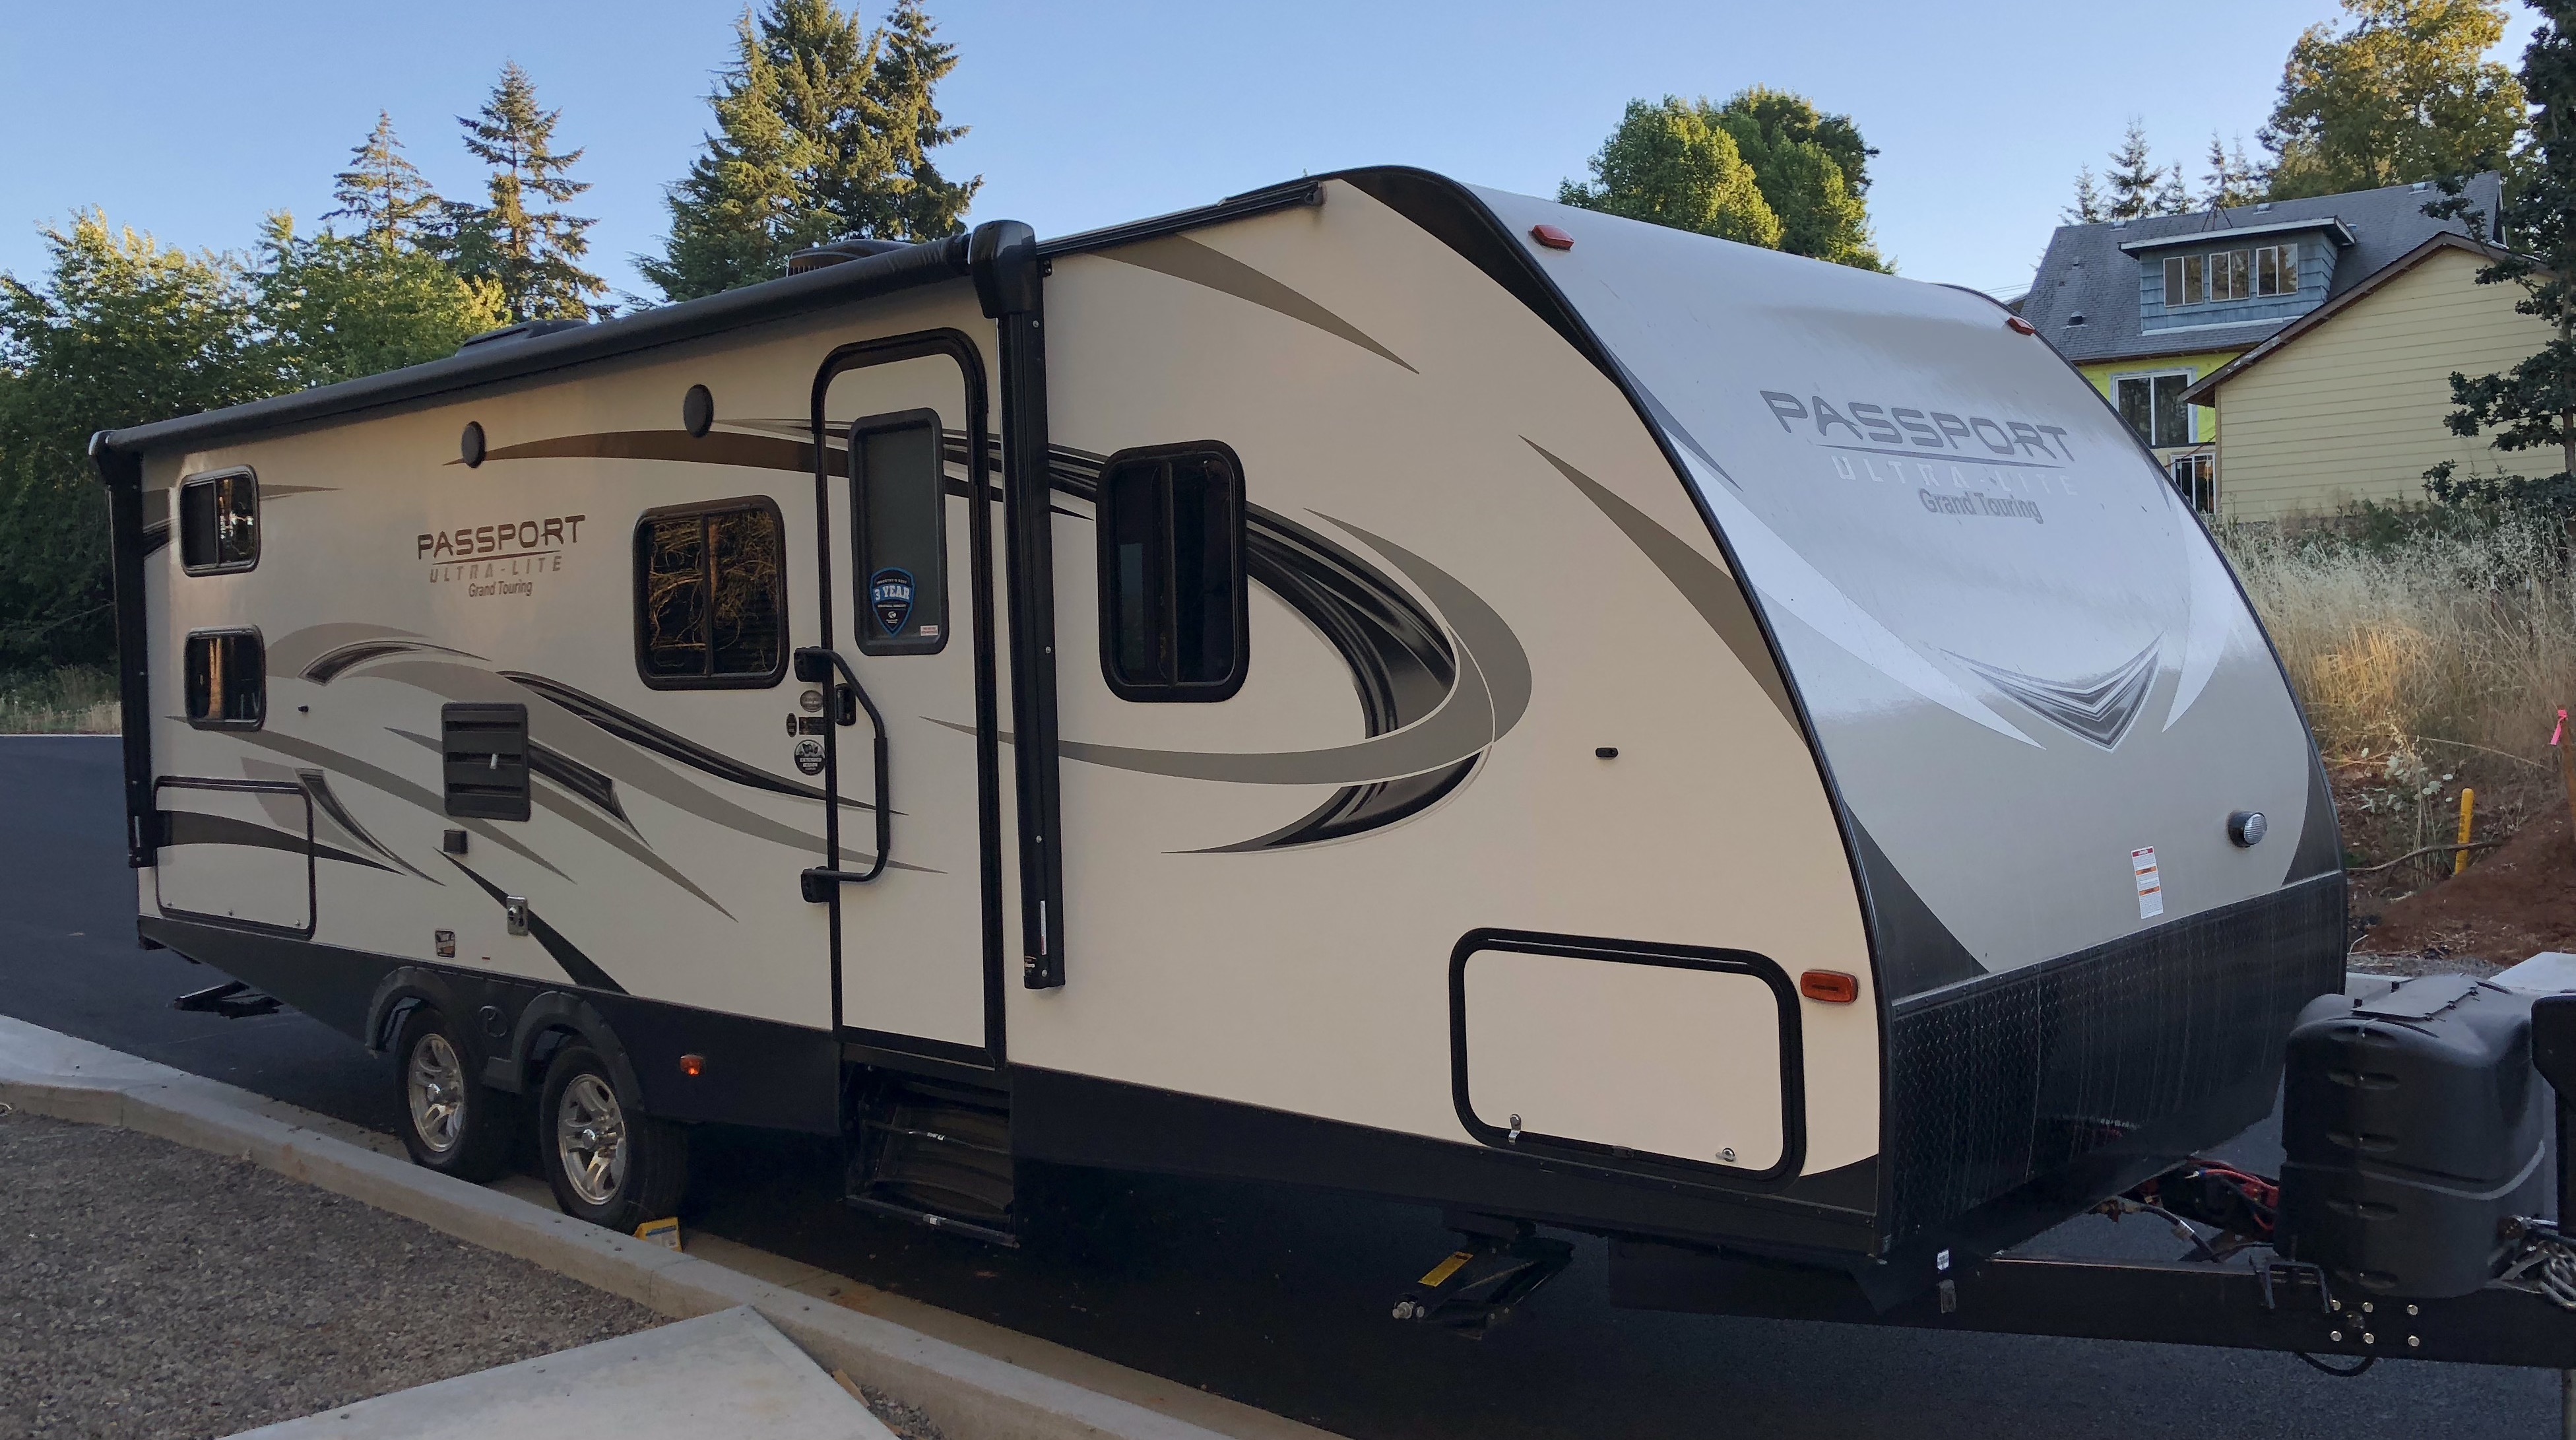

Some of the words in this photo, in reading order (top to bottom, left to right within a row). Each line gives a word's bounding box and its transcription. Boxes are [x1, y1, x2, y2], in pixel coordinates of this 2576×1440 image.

[1759, 390, 2076, 462] PASSPORT
[1917, 487, 1976, 515] Grand
[1974, 491, 2044, 525] Touring
[417, 513, 586, 560] PASSPORT
[430, 556, 562, 583] ULTRA-LITE
[468, 581, 496, 597] Grand
[498, 579, 533, 597] Touring
[874, 588, 881, 601] 3
[882, 585, 910, 600] YEAR
